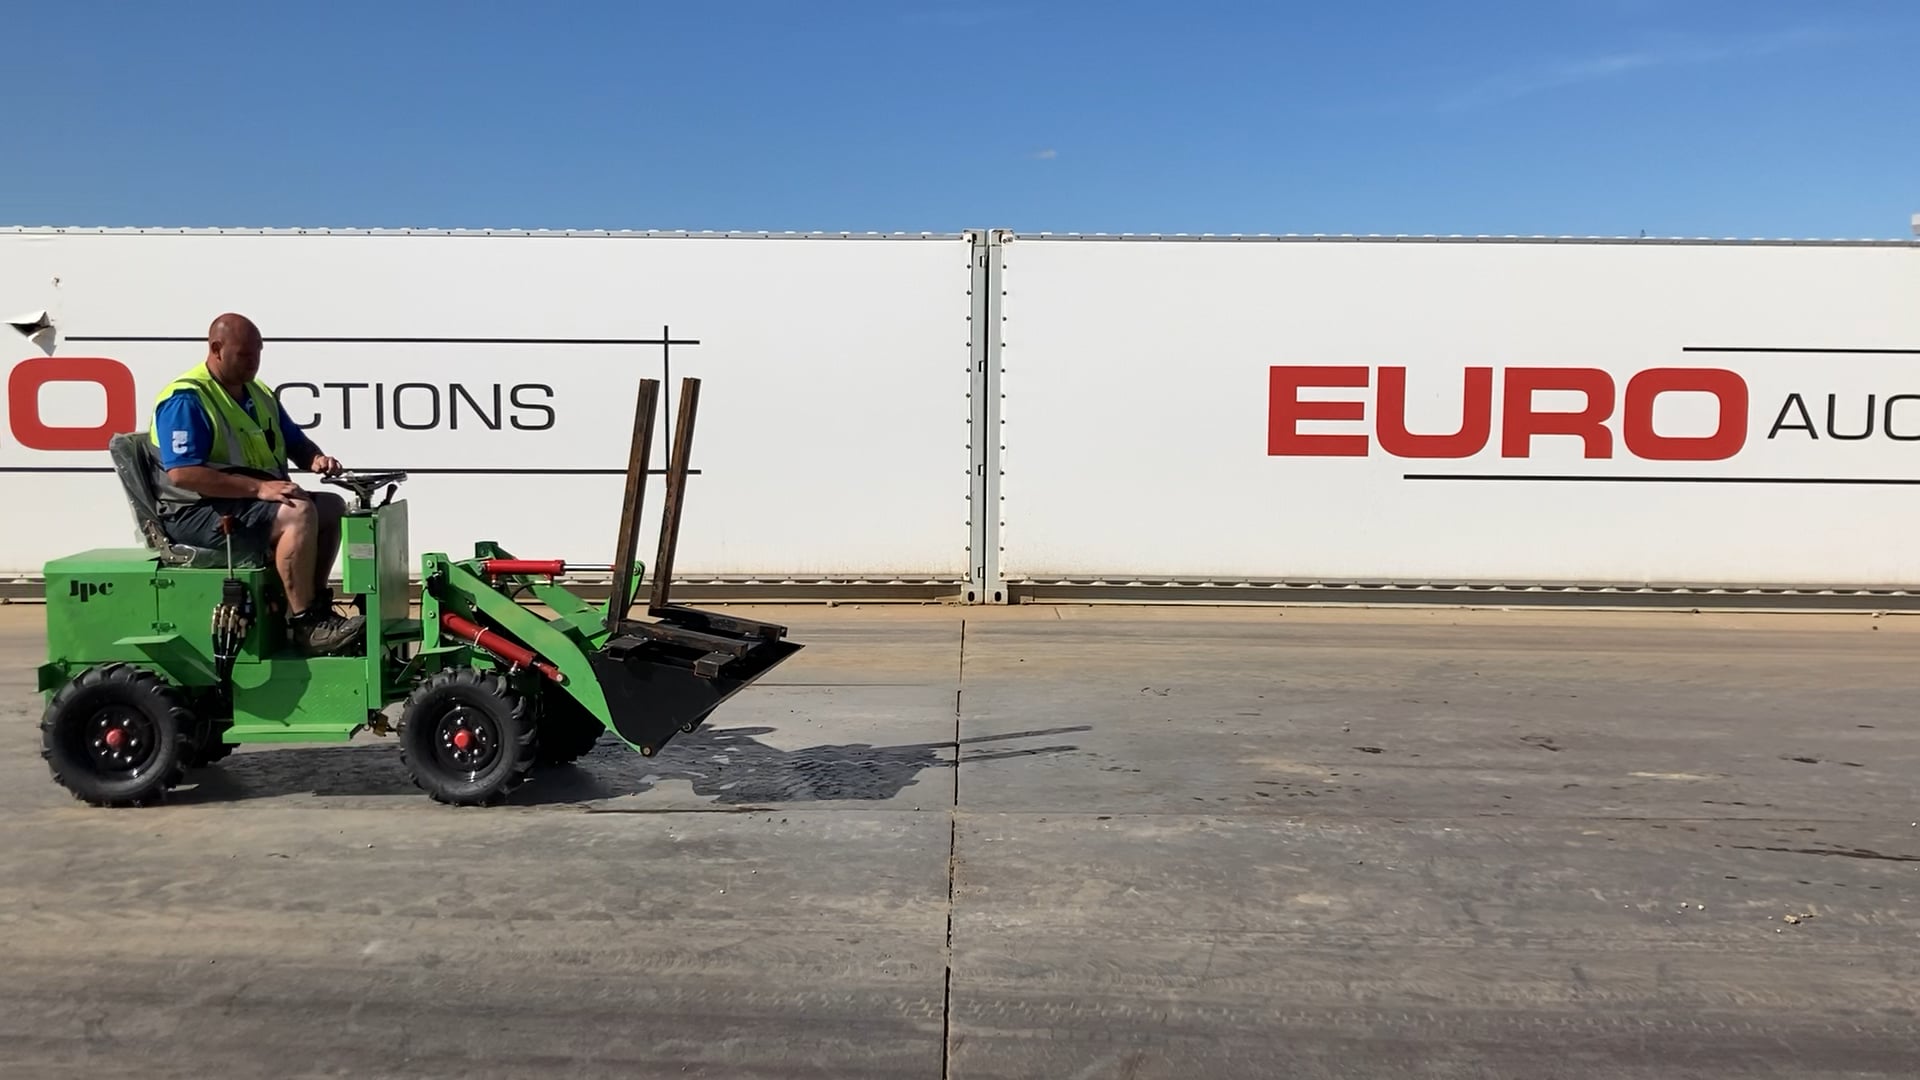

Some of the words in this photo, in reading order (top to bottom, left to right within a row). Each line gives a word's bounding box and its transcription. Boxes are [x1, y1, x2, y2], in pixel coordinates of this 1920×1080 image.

[274, 382, 556, 431] CTIONS
[1267, 365, 1749, 461] EURO
[1767, 393, 1920, 441] AUC
